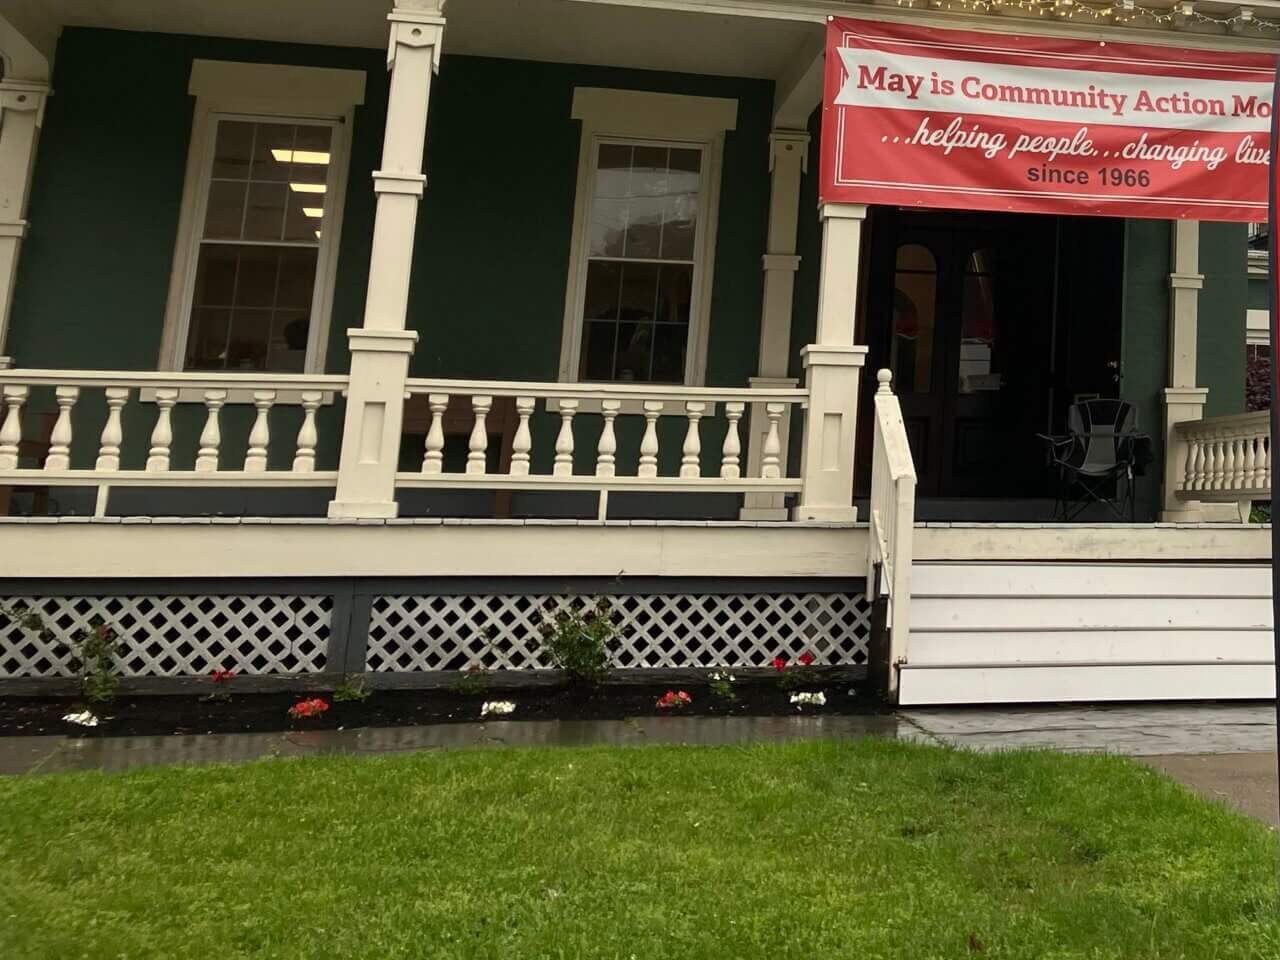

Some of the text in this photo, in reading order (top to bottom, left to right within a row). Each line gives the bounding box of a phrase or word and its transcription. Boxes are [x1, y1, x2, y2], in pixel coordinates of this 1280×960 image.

[856, 64, 924, 100] May
[929, 71, 955, 96] is
[960, 76, 1128, 117] Community
[1133, 89, 1226, 117] Action
[881, 116, 1008, 159] ...helping
[1027, 162, 1151, 188] since 1966
